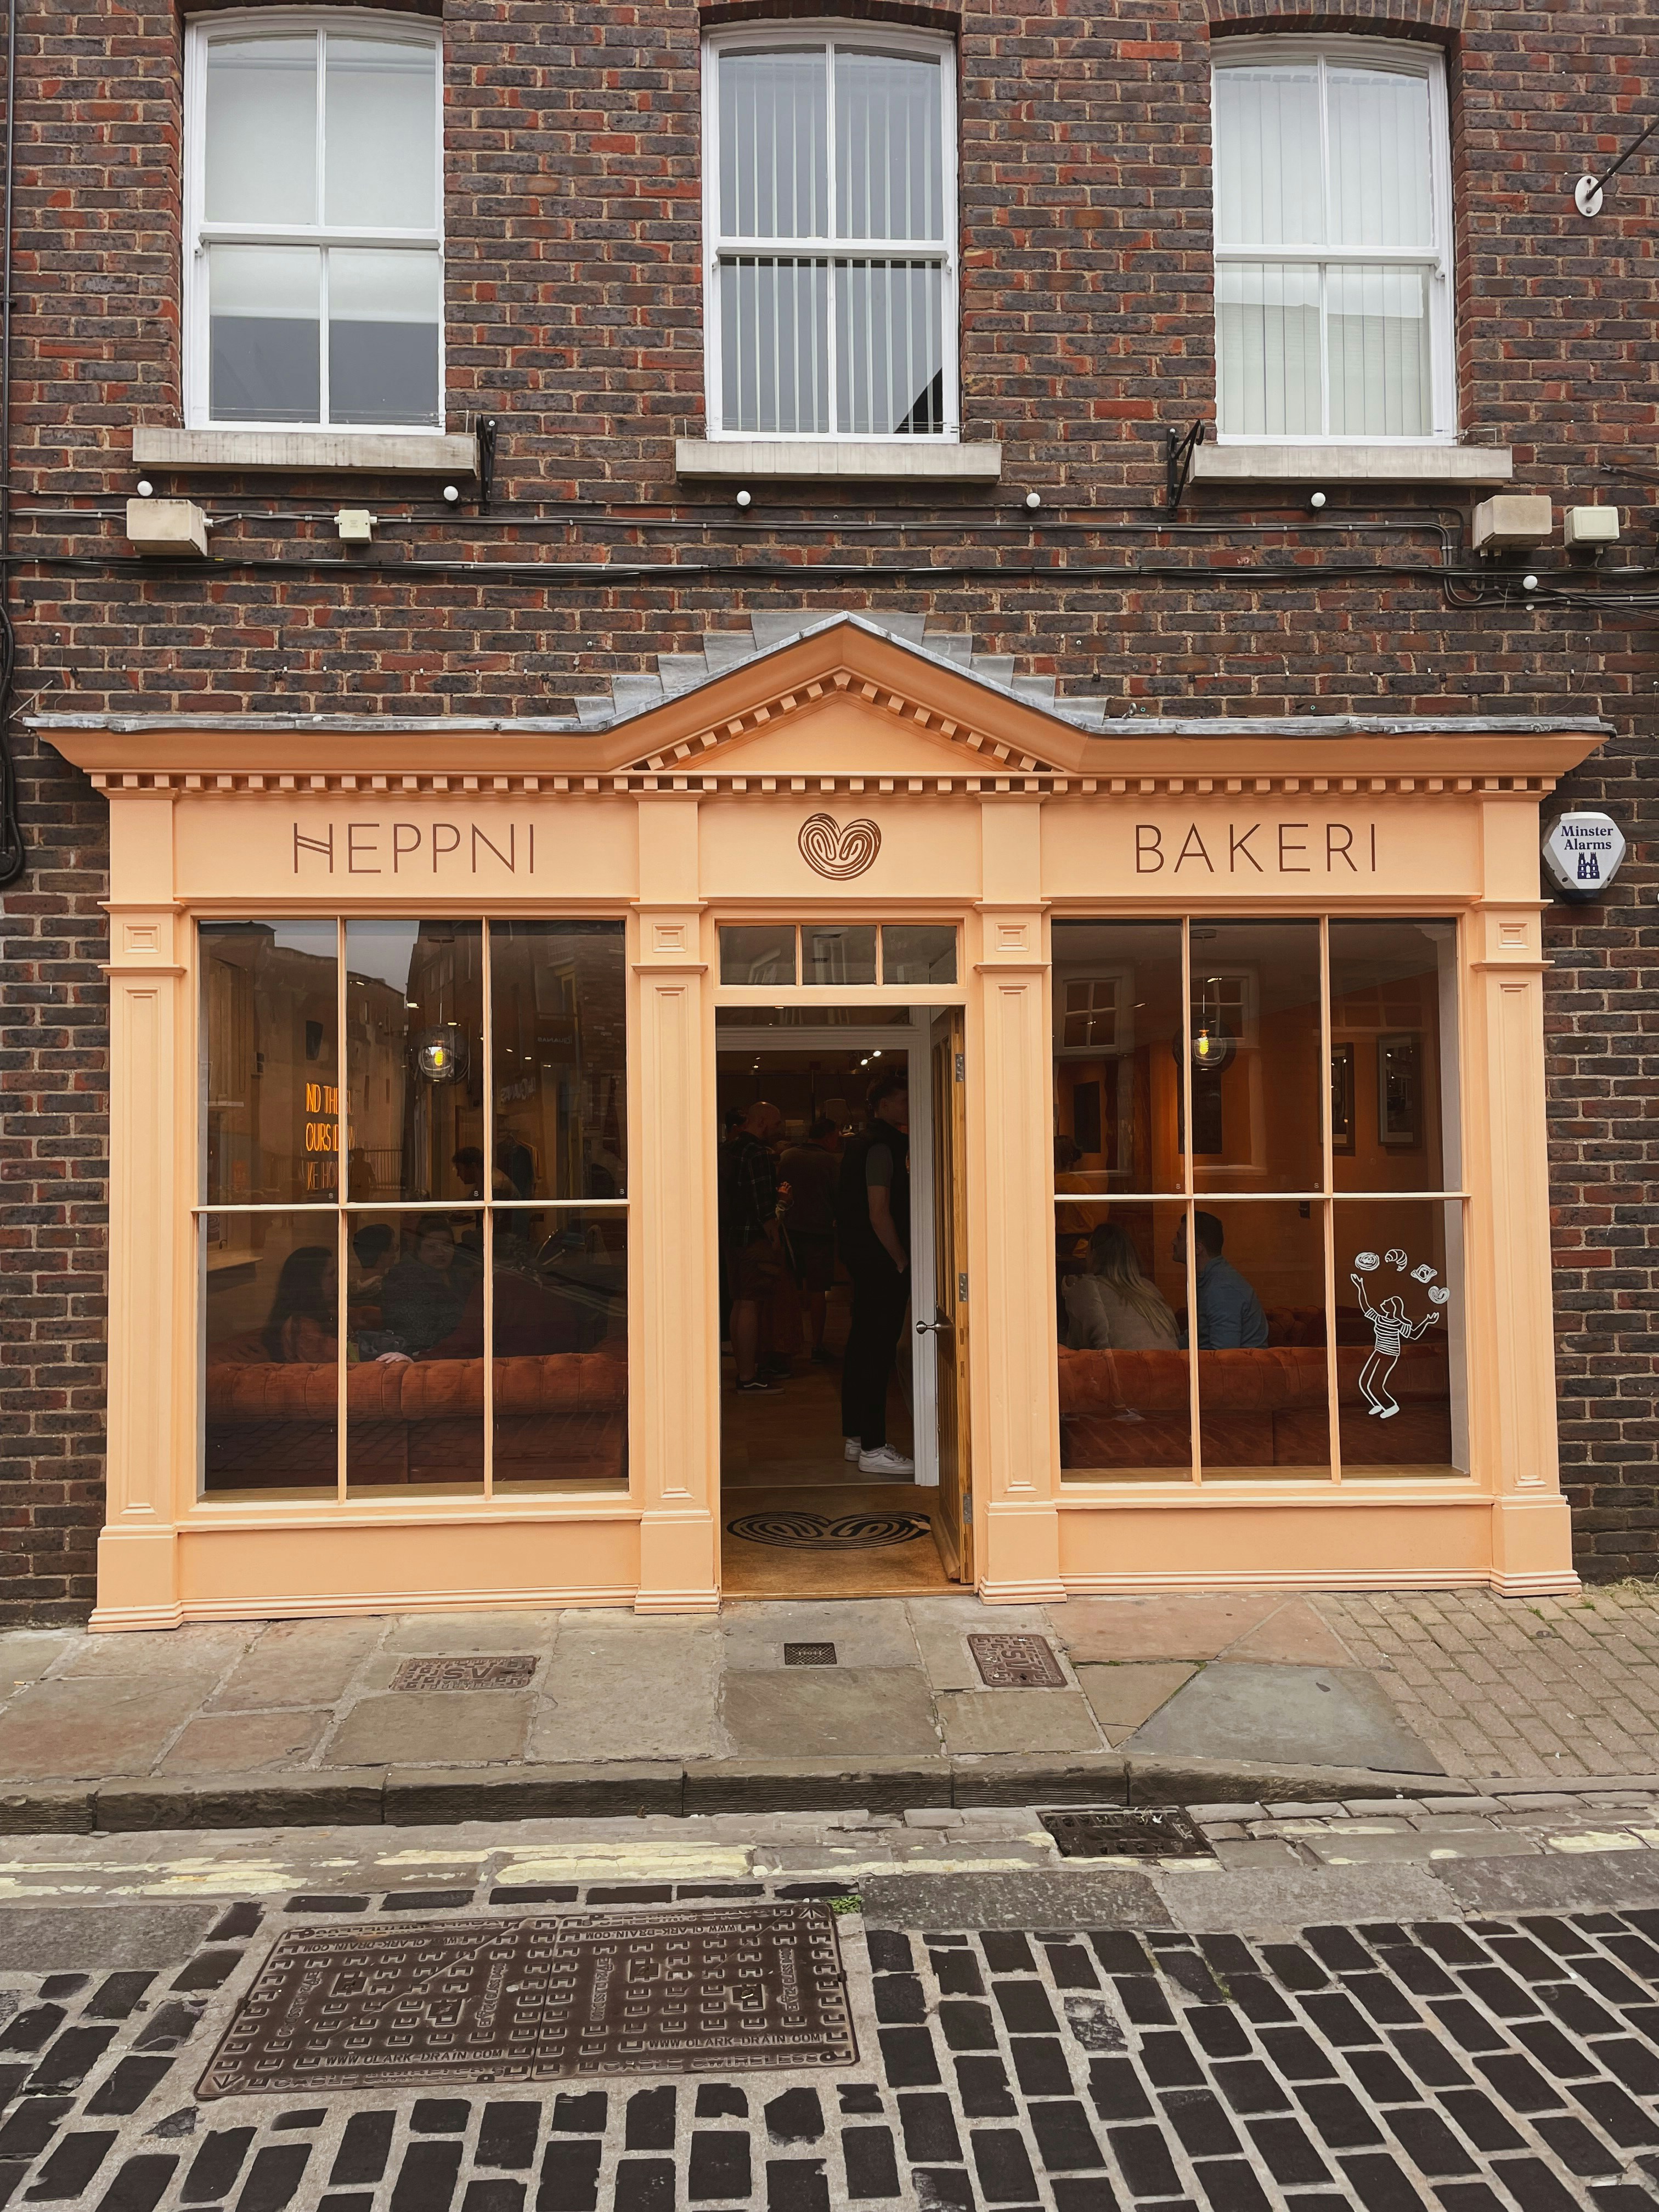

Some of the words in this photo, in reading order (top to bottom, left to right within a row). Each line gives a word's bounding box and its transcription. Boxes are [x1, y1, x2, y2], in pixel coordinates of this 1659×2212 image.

[1561, 826, 1613, 837] Minster
[1564, 838, 1612, 850] Alarms
[294, 823, 534, 873] HEPPNI
[1136, 823, 1376, 873] BAKERI
